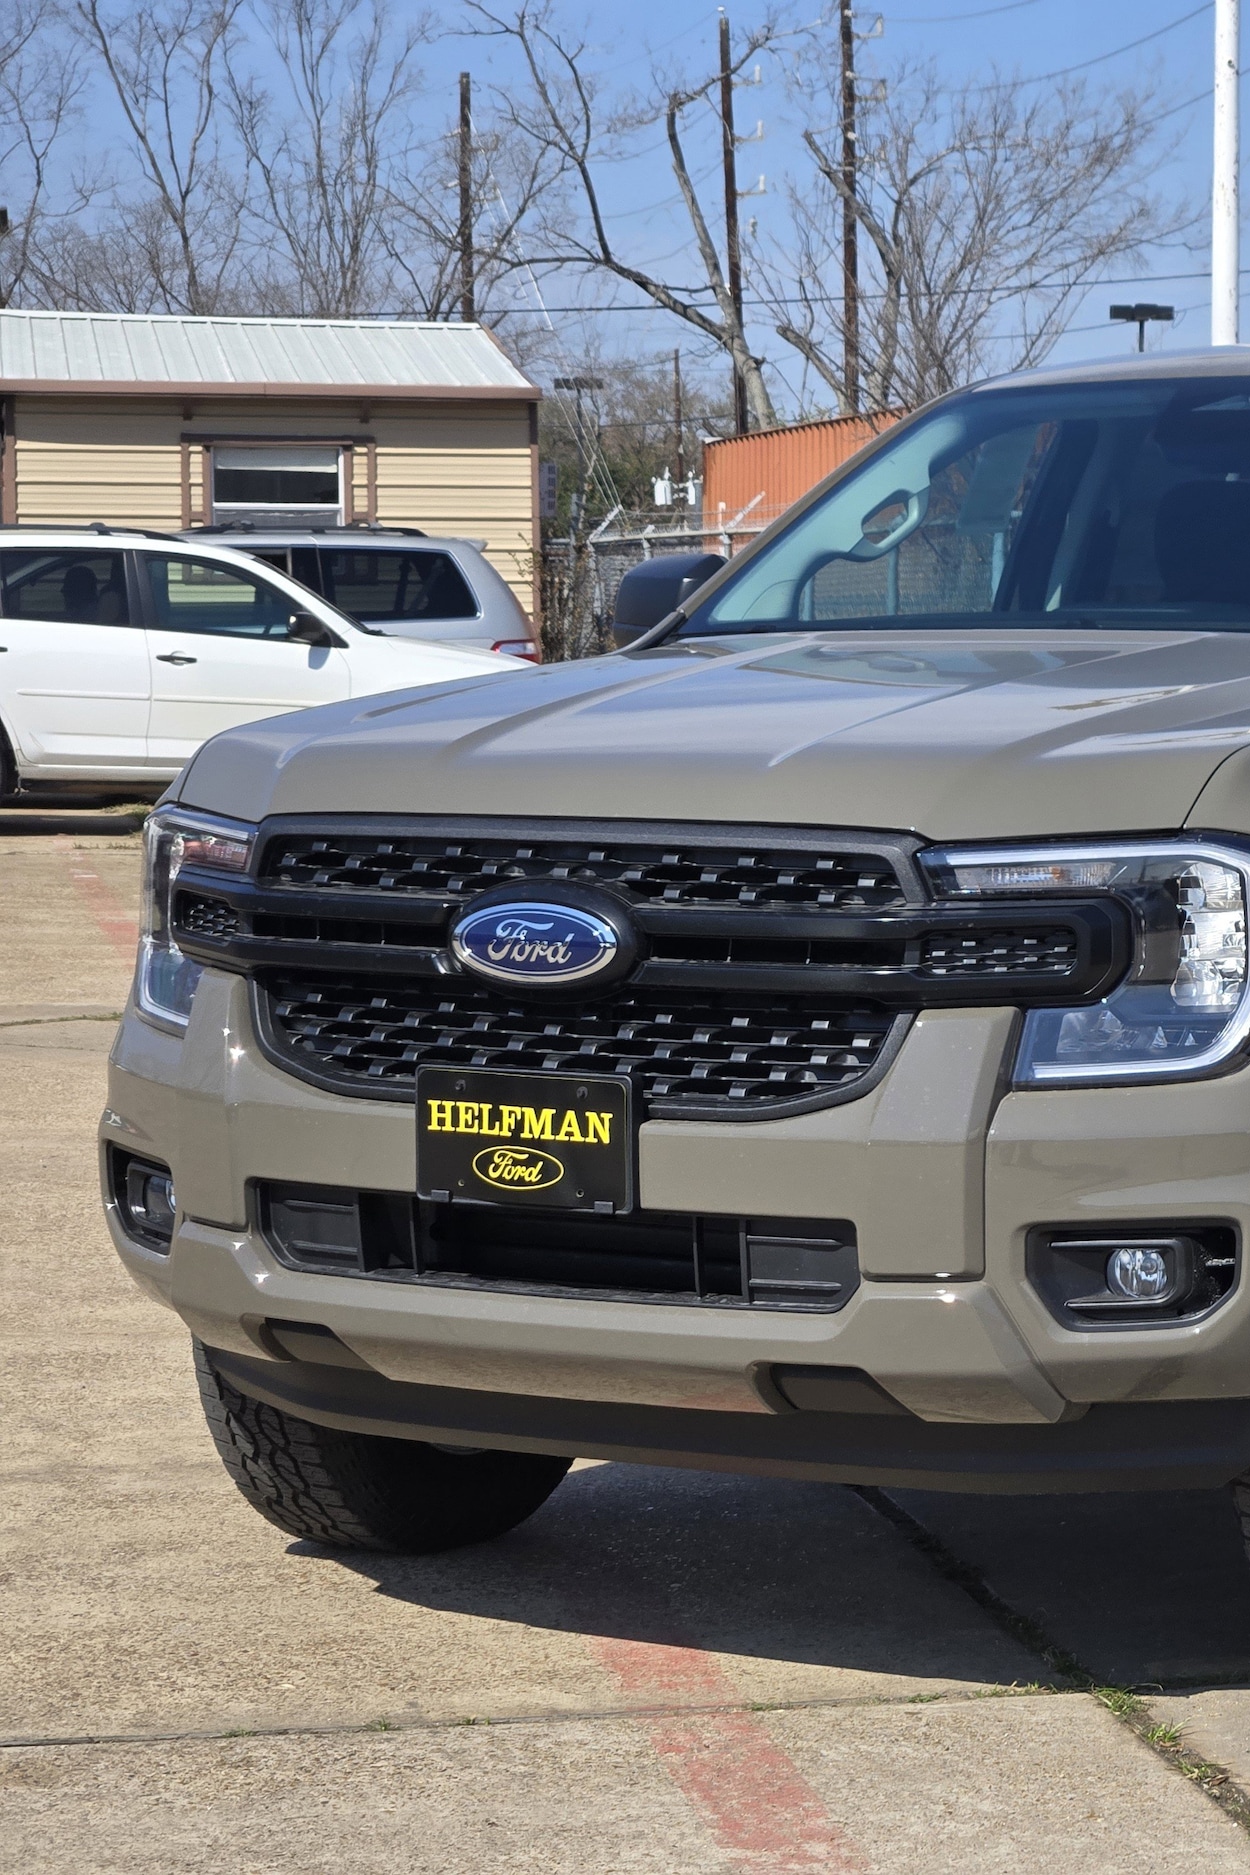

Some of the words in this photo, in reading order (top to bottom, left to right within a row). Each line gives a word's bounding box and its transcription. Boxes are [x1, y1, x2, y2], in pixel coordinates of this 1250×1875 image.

[488, 918, 574, 965] Ford
[427, 1099, 613, 1144] HELFMAN
[488, 1151, 544, 1183] Ford
